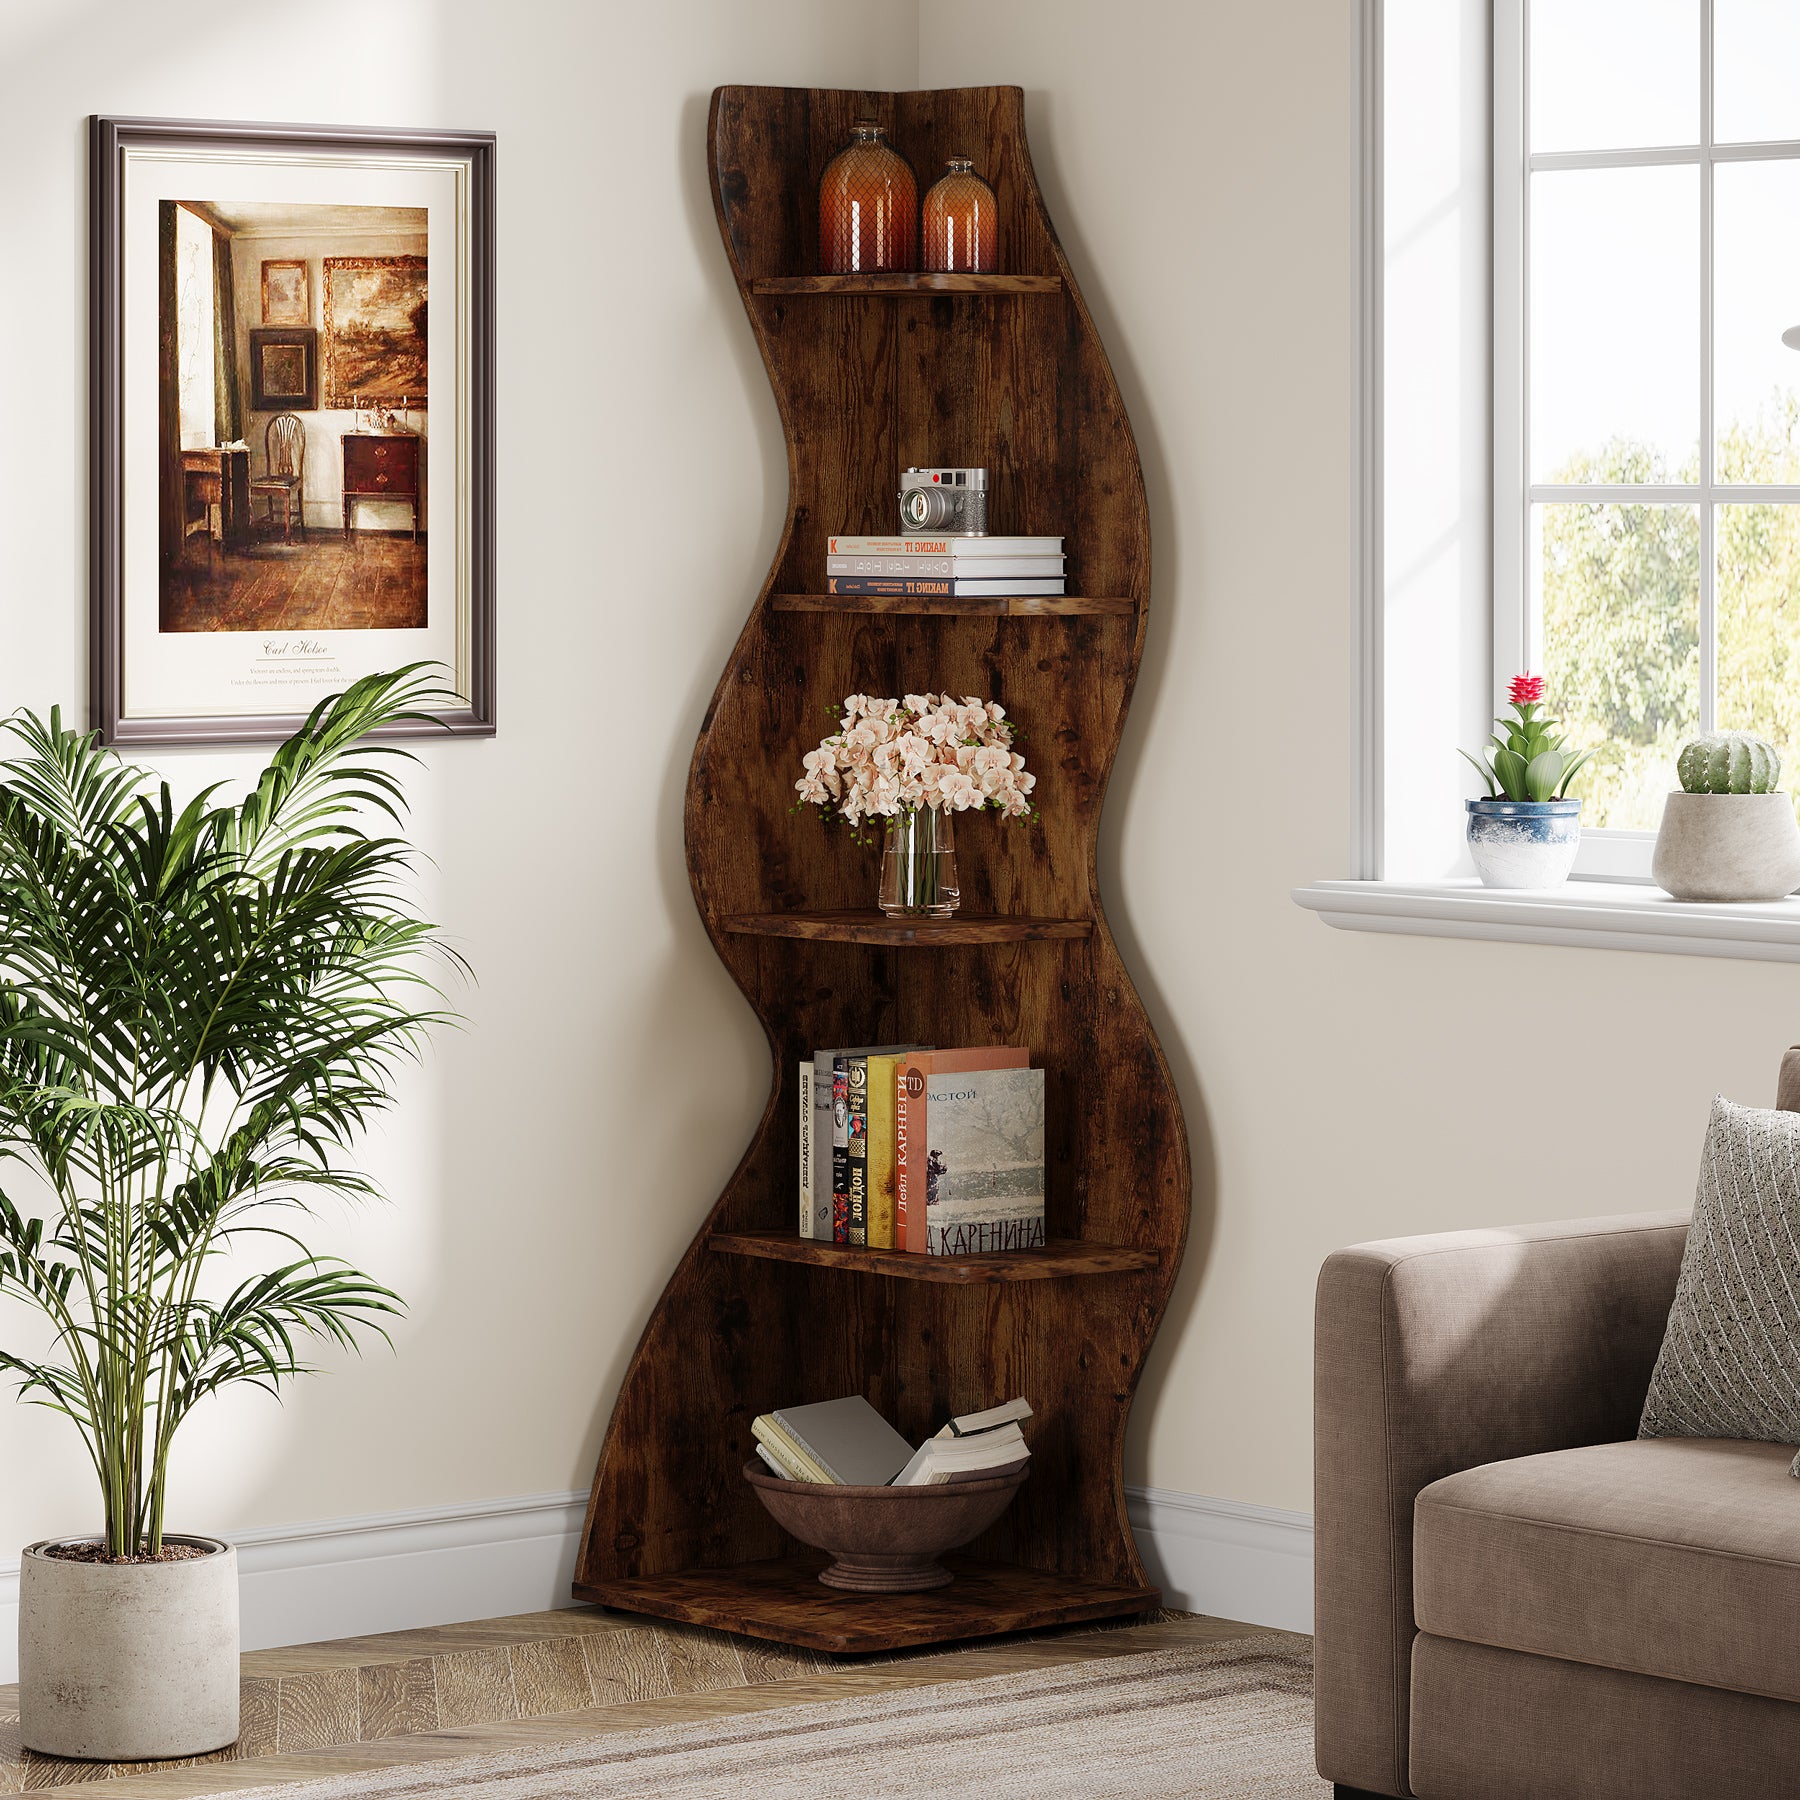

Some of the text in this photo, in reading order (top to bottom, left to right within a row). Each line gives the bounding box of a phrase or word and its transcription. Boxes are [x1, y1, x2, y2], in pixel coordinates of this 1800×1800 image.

[830, 539, 838, 553] K
[829, 579, 838, 594] K
[263, 640, 289, 656] Carl
[898, 1074, 907, 1167] КАРНЕГИ
[852, 1167, 865, 1221] ЛОНДОН
[941, 1217, 1045, 1256] КАРЕНИНА
